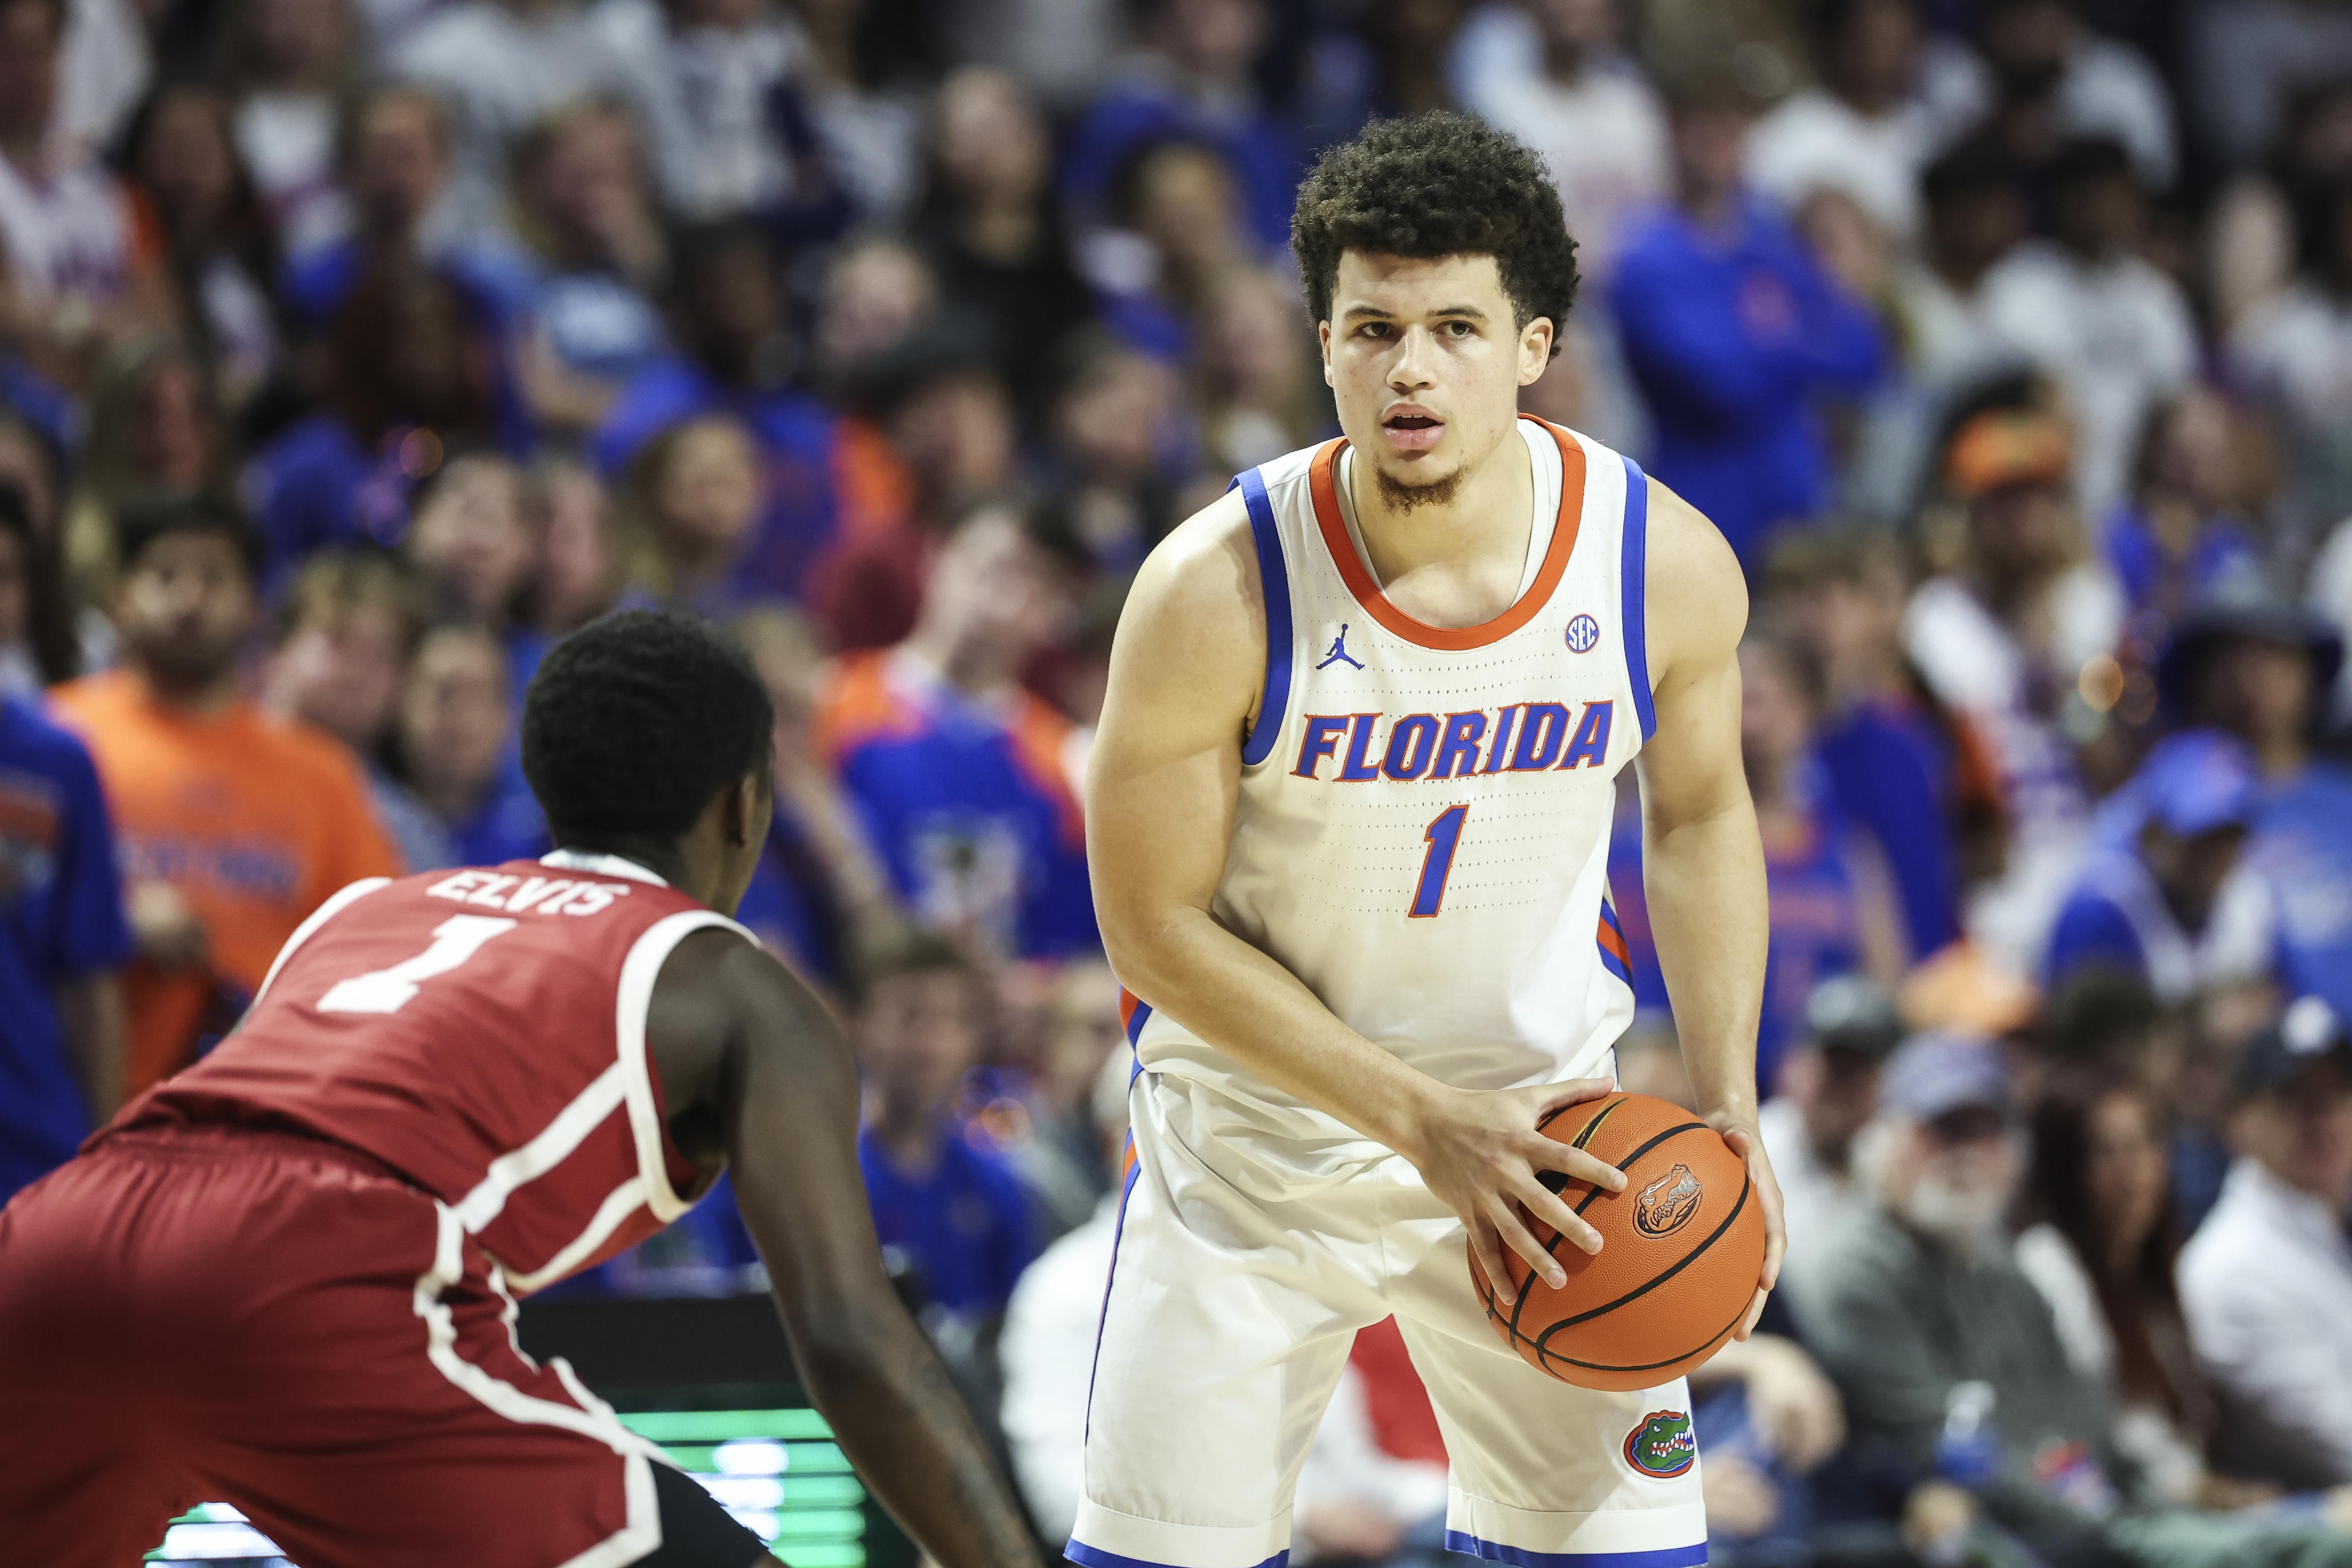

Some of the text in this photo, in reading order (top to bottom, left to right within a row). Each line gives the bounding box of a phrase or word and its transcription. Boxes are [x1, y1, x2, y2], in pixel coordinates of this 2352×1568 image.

[1568, 617, 1596, 650] SEC
[1289, 699, 1613, 783] FLORIDA
[426, 869, 631, 917] ELVIS
[1408, 804, 1470, 918] 1
[315, 913, 518, 1014] 1
